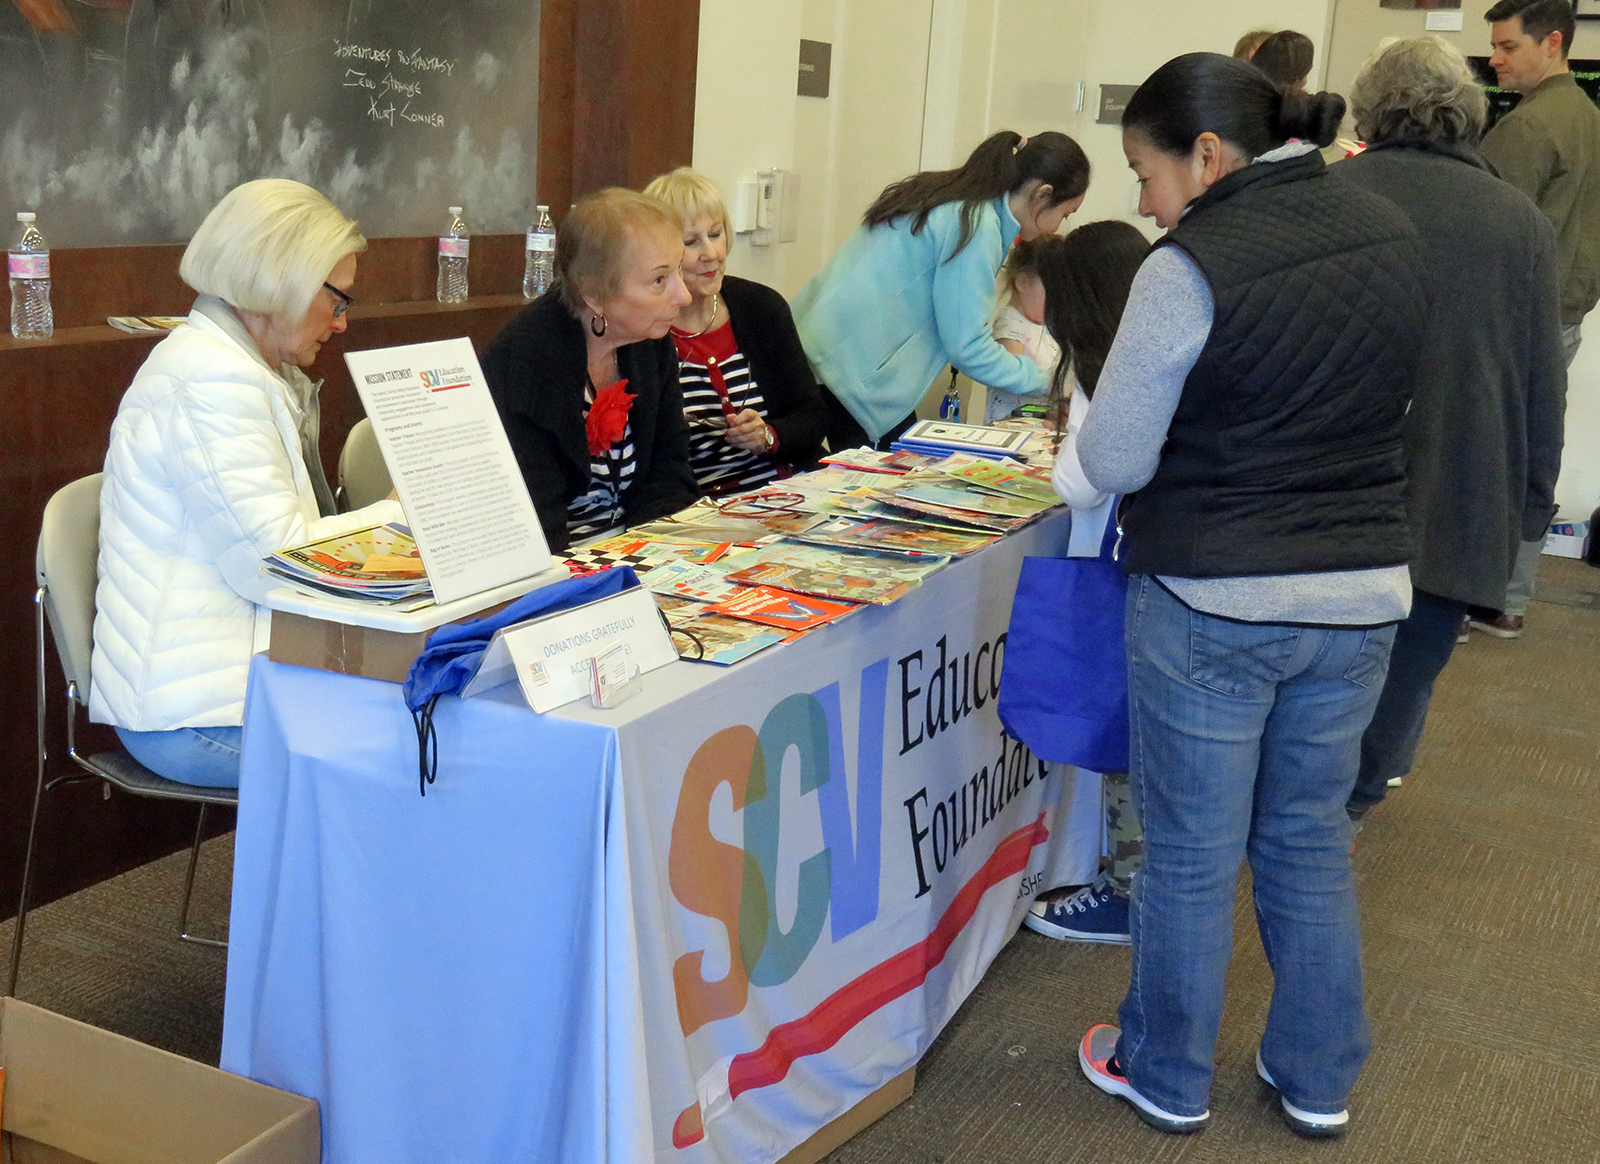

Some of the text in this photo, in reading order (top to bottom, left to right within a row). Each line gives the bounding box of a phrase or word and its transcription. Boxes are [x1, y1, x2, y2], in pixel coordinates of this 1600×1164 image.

[364, 368, 413, 385] MISSION STATEMENT
[420, 369, 441, 388] SCV
[439, 366, 465, 377] Education
[442, 374, 472, 386] Foundation
[543, 631, 592, 658] DONATIONS
[591, 616, 637, 641] GRATEFULLY
[668, 657, 889, 1037] SCV
